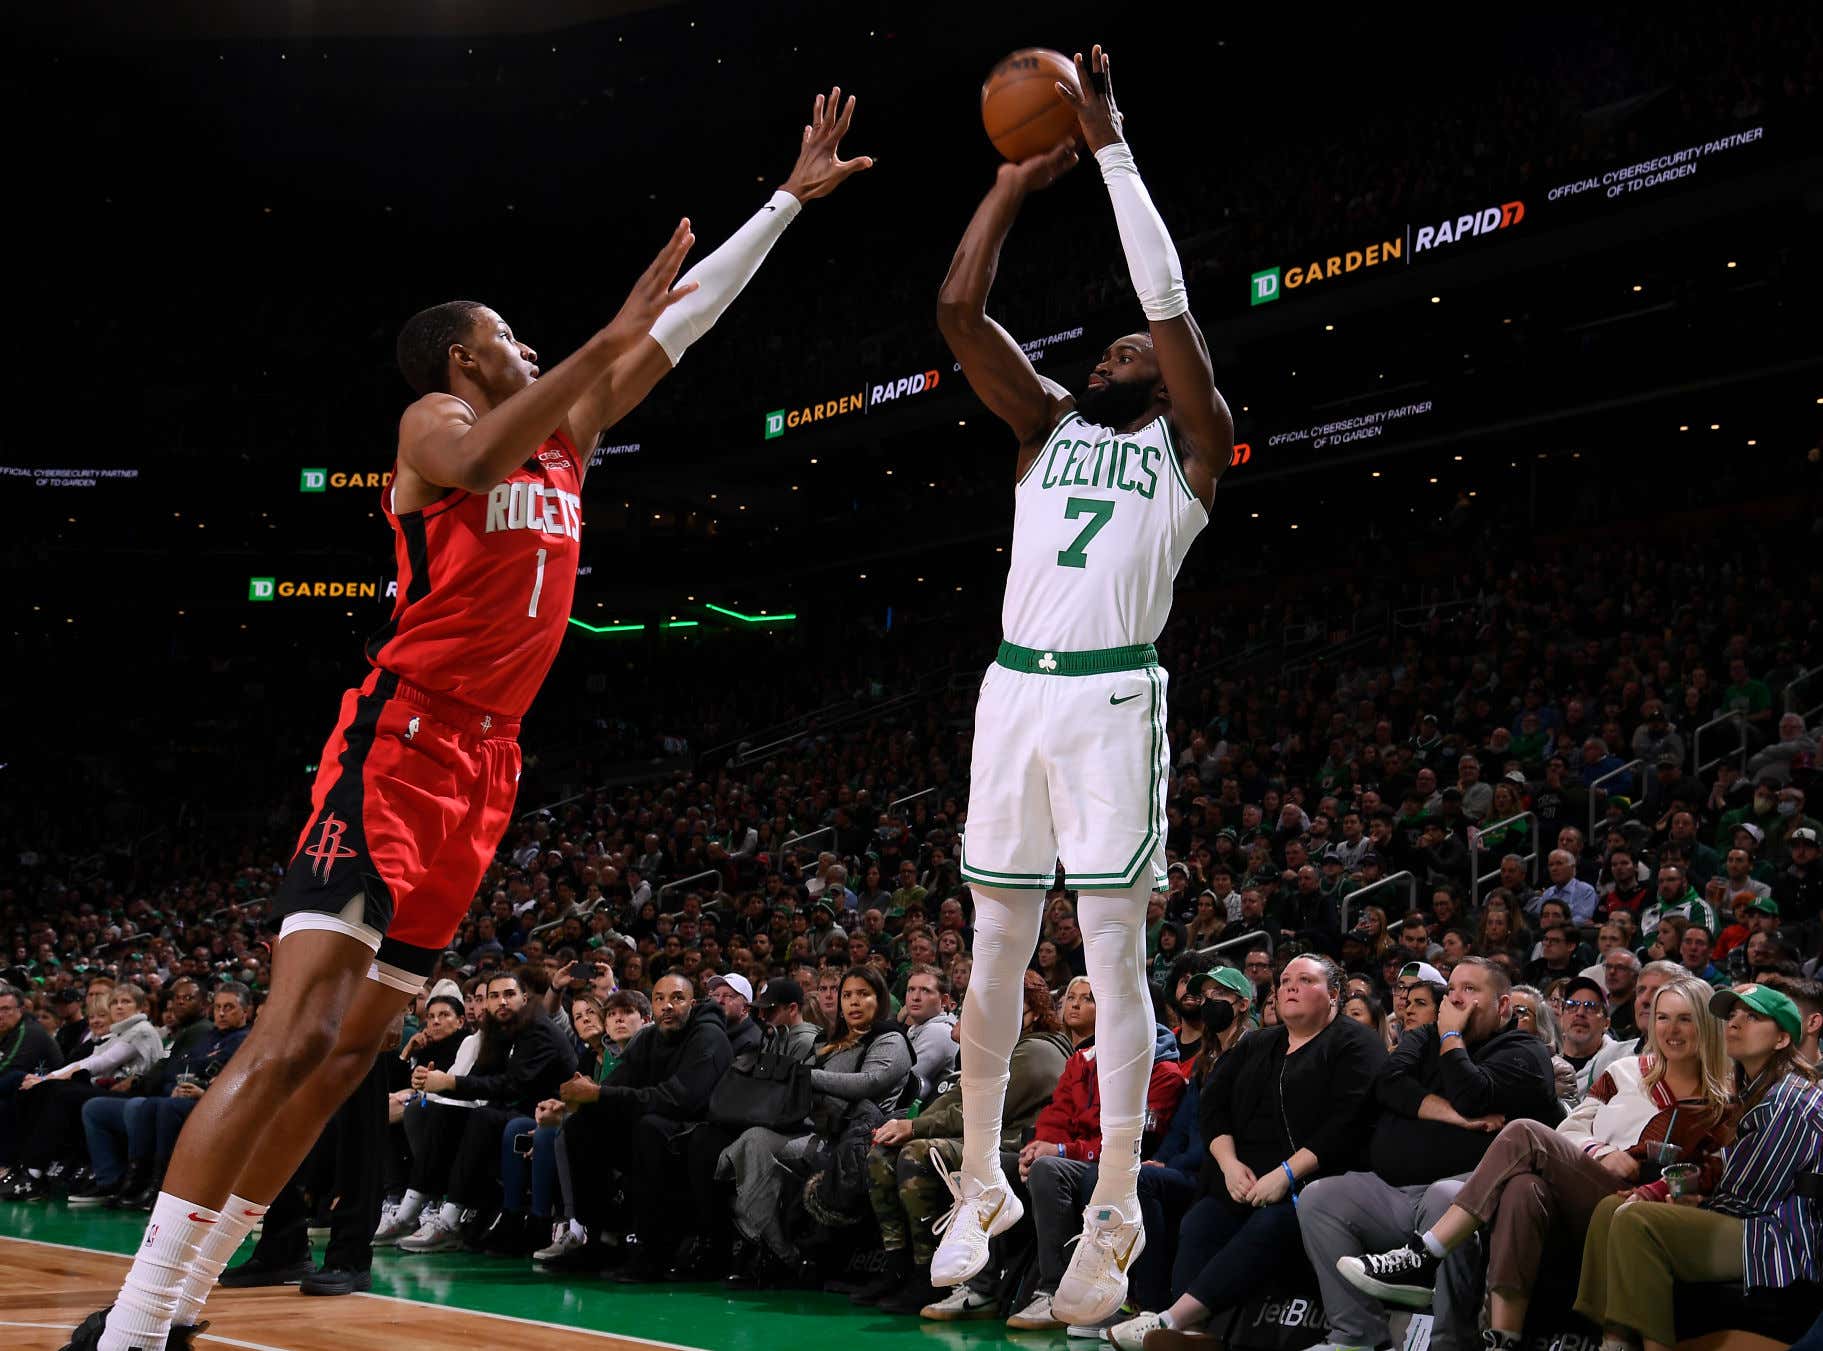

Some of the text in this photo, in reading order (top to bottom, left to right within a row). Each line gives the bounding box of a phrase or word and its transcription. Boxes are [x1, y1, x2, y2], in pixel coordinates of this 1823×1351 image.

[1548, 127, 1764, 200] OFFICIAL CYBERSECURITY PARTNER
[1607, 163, 1697, 198] OF TD GARDEN
[1284, 238, 1402, 289] GARDEN
[1048, 327, 1083, 345] PARTNER
[786, 392, 863, 428] GARDEN
[1269, 401, 1432, 446] OFFICIAL CYBERSECURITY PARTNER
[606, 443, 641, 455] PARTNER
[1314, 426, 1383, 448] OF TD GARDEN
[34, 469, 100, 477] CYBERSECURITY
[101, 469, 138, 477] PARTNER
[36, 478, 48, 486] OF
[61, 478, 97, 486] GARDEN
[330, 472, 392, 488] GARD
[1041, 439, 1162, 500] CELTICS
[1056, 496, 1116, 569] 7
[278, 581, 376, 597] GARDEN
[528, 548, 547, 618] 1
[1252, 1295, 1327, 1328] jetBlu
